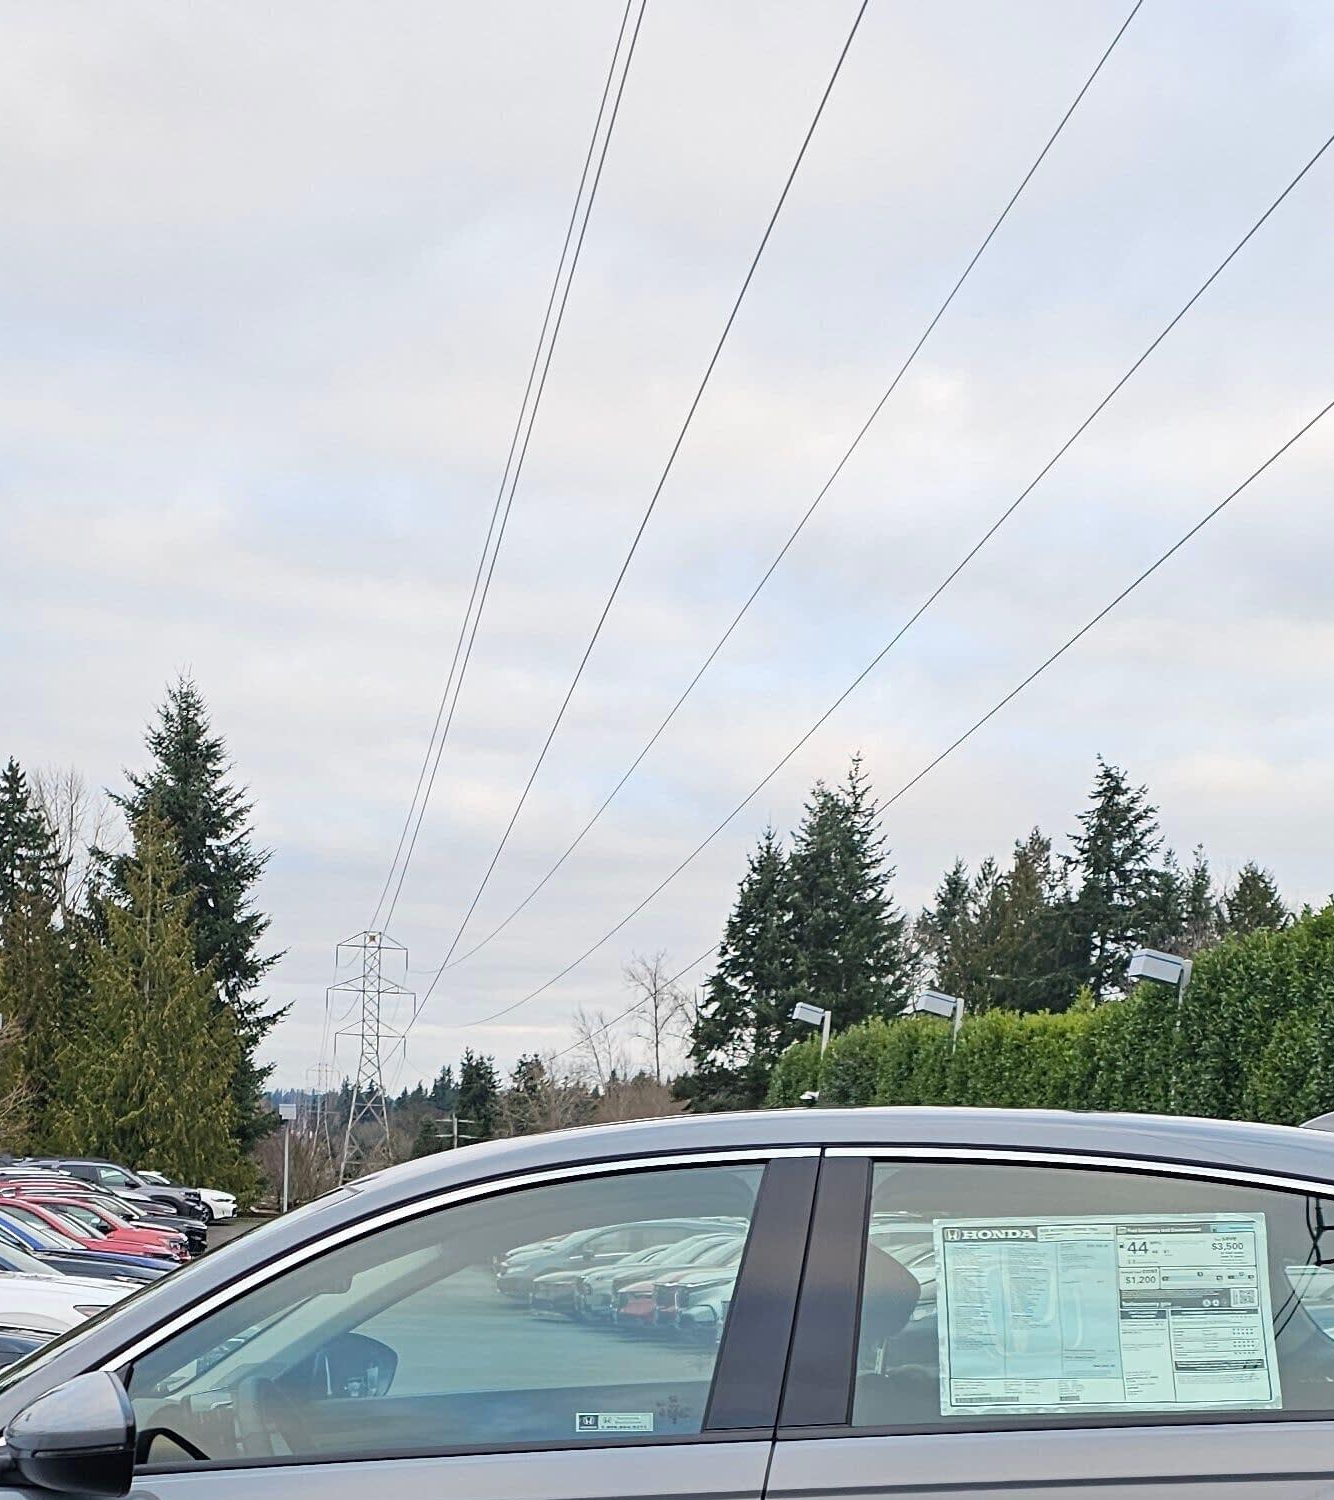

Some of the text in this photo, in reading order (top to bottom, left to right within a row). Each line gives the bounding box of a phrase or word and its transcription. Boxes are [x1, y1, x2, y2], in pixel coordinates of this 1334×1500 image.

[961, 1229, 1036, 1240] HONDA
[1127, 1241, 1149, 1254] 44
[1211, 1242, 1244, 1251] $3,500
[1125, 1276, 1156, 1285] $1,200
